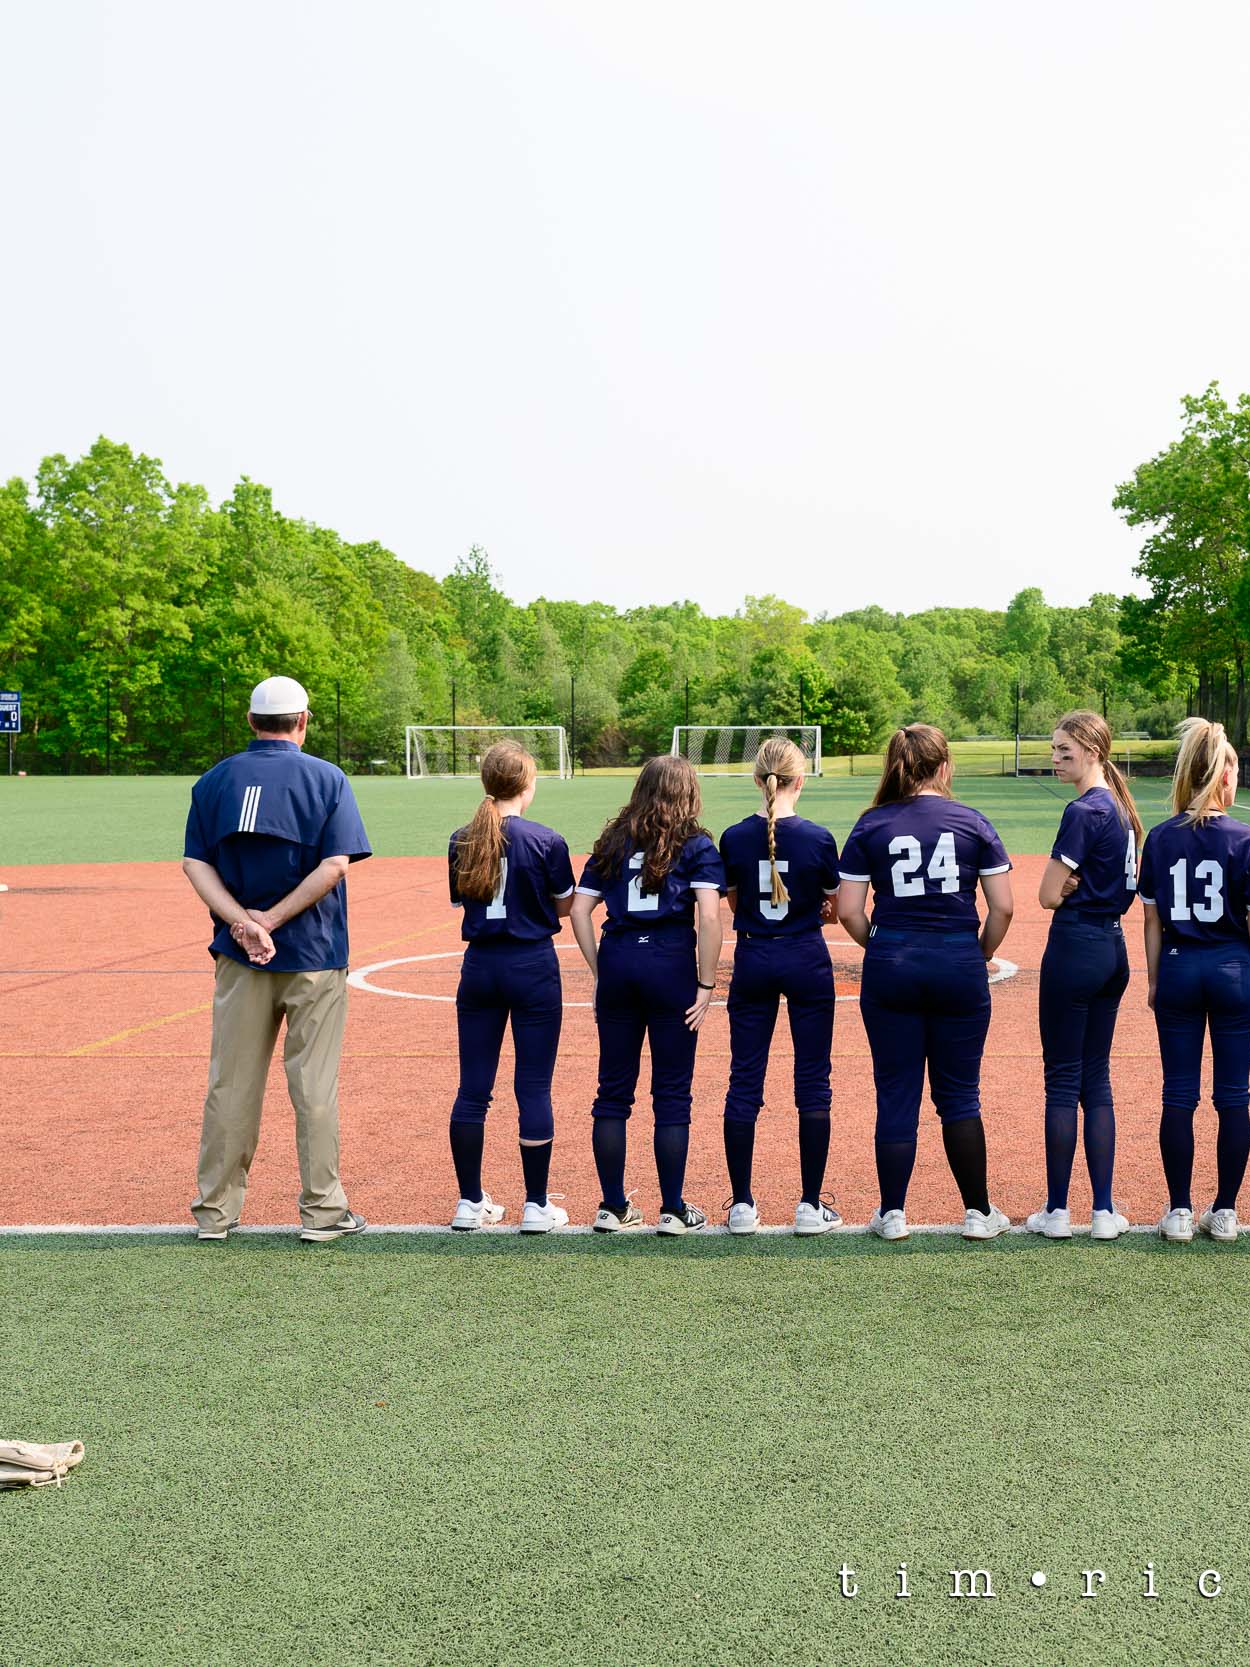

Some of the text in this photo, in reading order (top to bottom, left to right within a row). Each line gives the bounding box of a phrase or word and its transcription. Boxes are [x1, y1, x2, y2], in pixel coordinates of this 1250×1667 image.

[627, 851, 659, 912] 2
[758, 859, 790, 921] 5
[889, 832, 960, 898] 24
[1125, 829, 1137, 891] 4
[1169, 858, 1224, 923] 13
